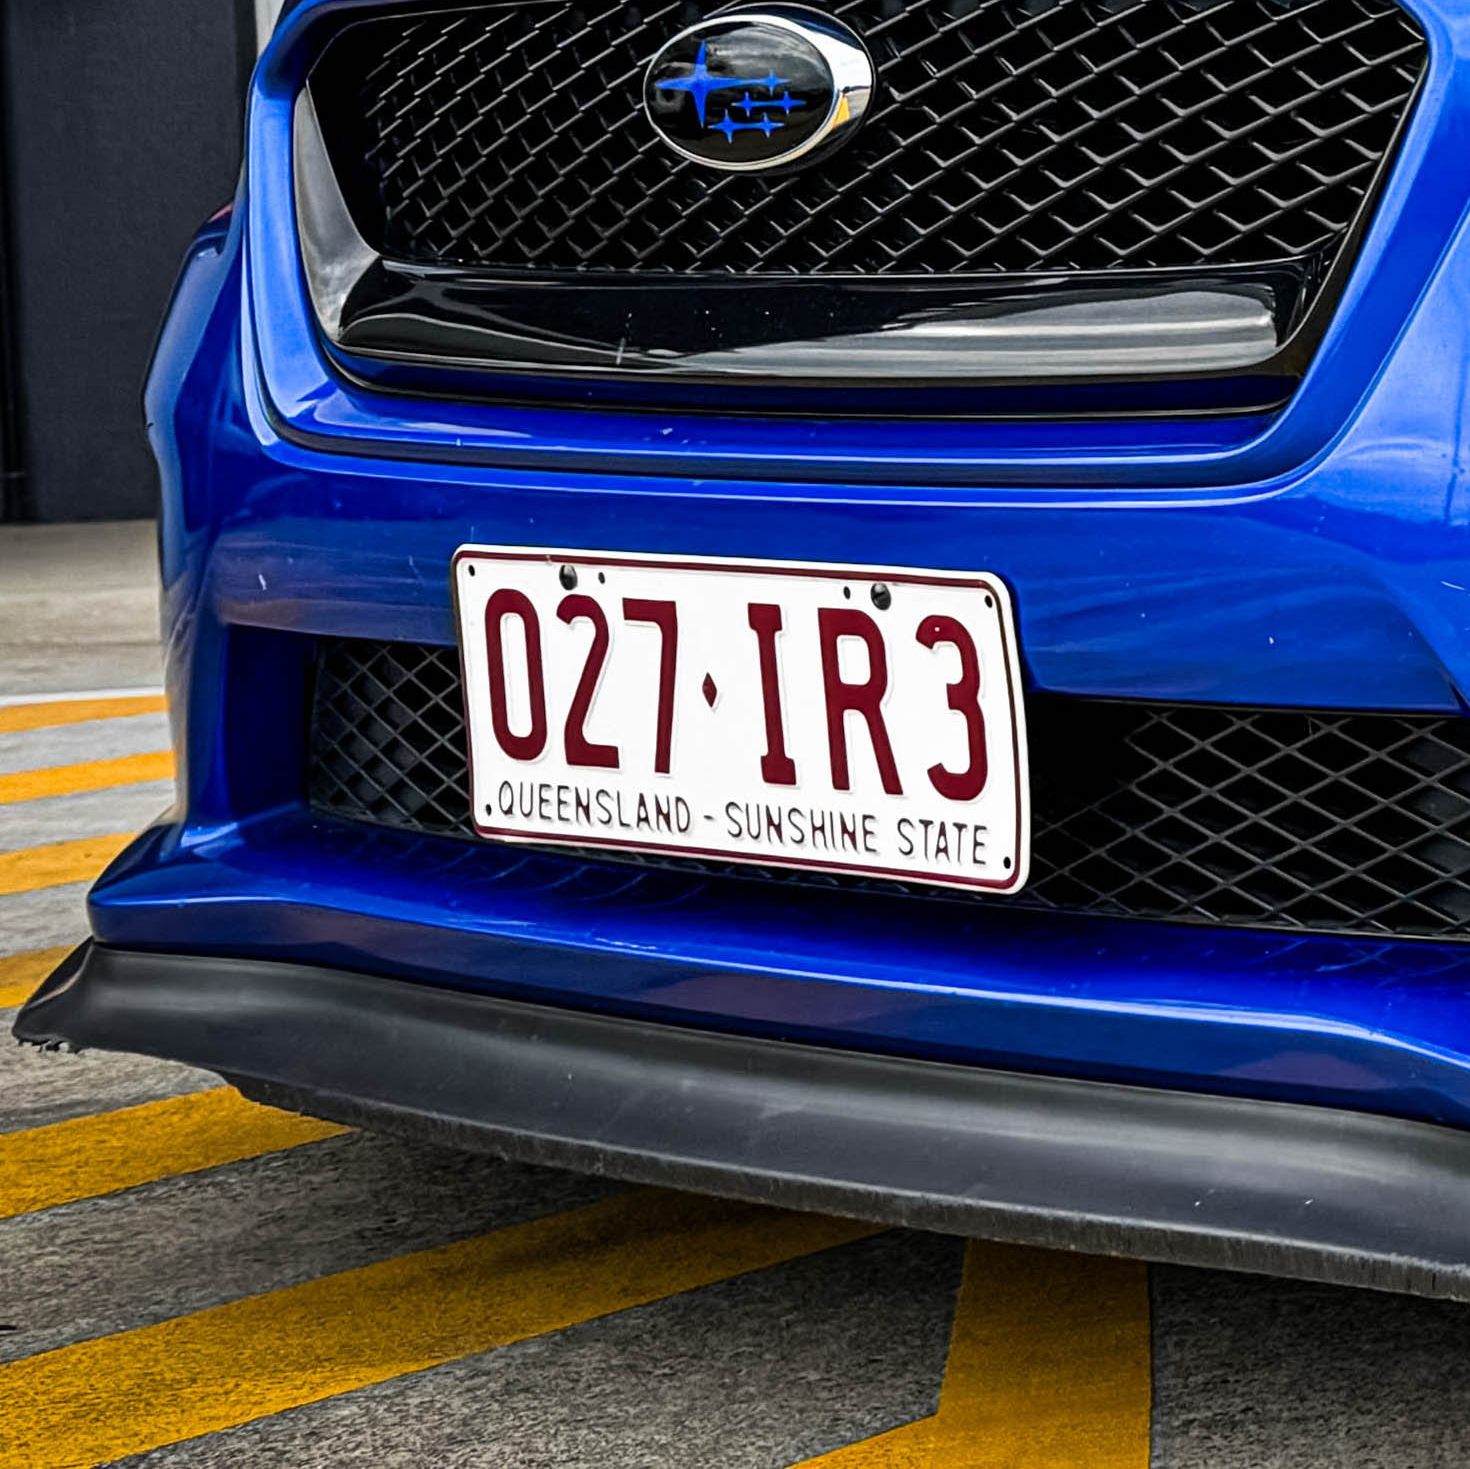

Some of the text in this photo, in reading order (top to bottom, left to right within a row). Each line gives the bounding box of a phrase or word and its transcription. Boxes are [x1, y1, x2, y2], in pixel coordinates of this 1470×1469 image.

[497, 781, 692, 834] QUEENSLAND
[725, 801, 878, 855] SUNSHINE
[897, 817, 989, 867] STATE
